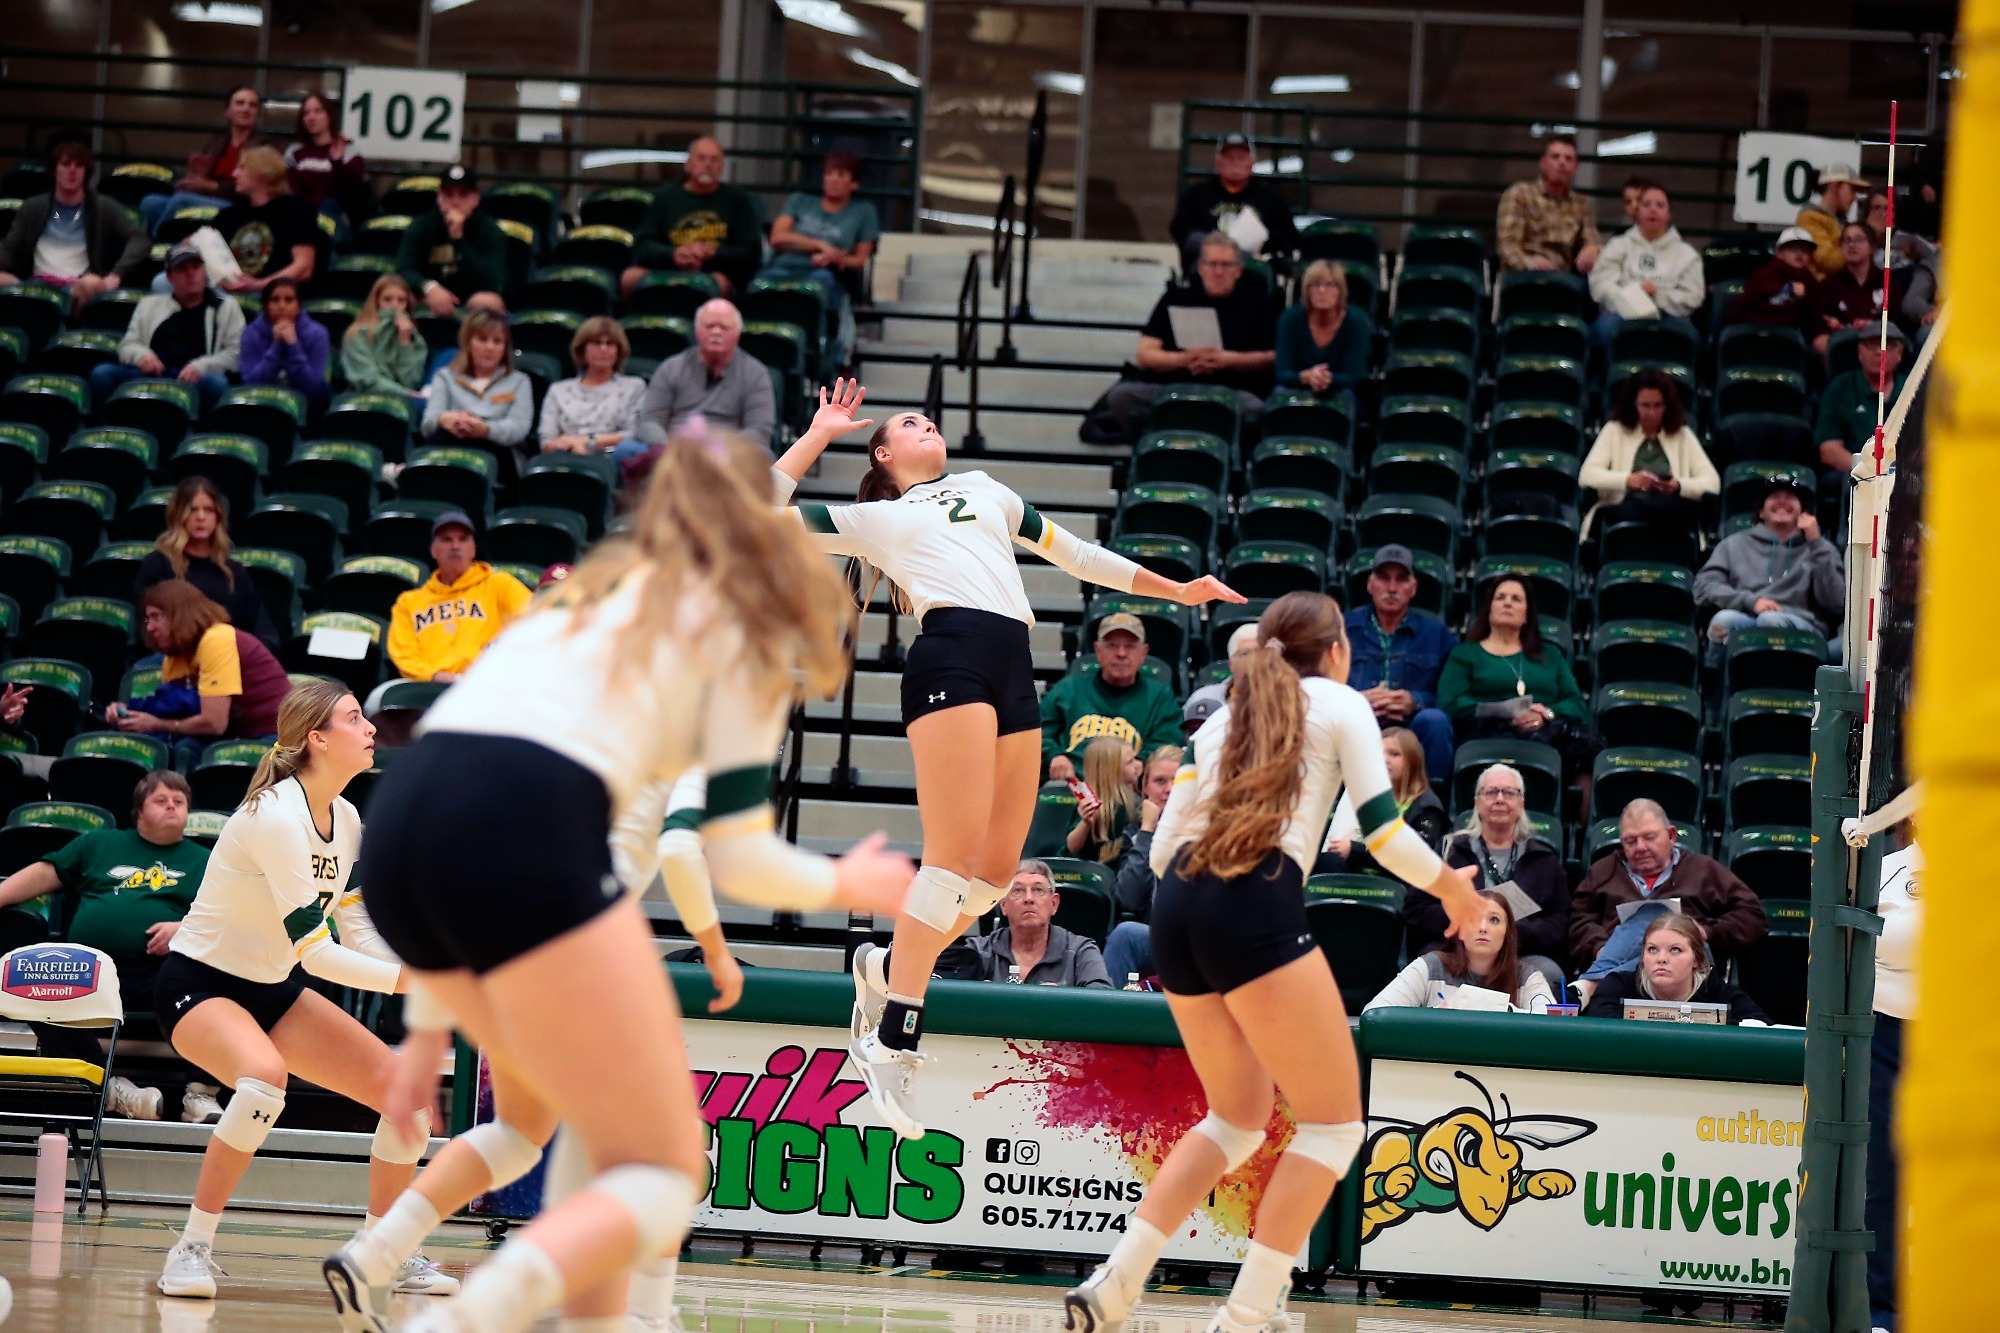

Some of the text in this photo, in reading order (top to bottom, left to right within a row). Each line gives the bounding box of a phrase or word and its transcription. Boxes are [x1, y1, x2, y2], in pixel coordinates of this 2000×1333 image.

[350, 91, 452, 141] 102
[1747, 156, 1814, 205] 10
[938, 497, 977, 523] 2
[414, 600, 485, 633] MESA
[318, 891, 335, 911] 7
[16, 958, 90, 973] FAIRFIELD
[28, 986, 73, 997] Marriott
[698, 1116, 966, 1225] IGNS
[983, 1172, 1144, 1203] QUIKSIGNS
[1583, 1151, 1801, 1240] univers
[982, 1204, 1128, 1234] 605.717.74
[1660, 1257, 1791, 1286] www.bh
